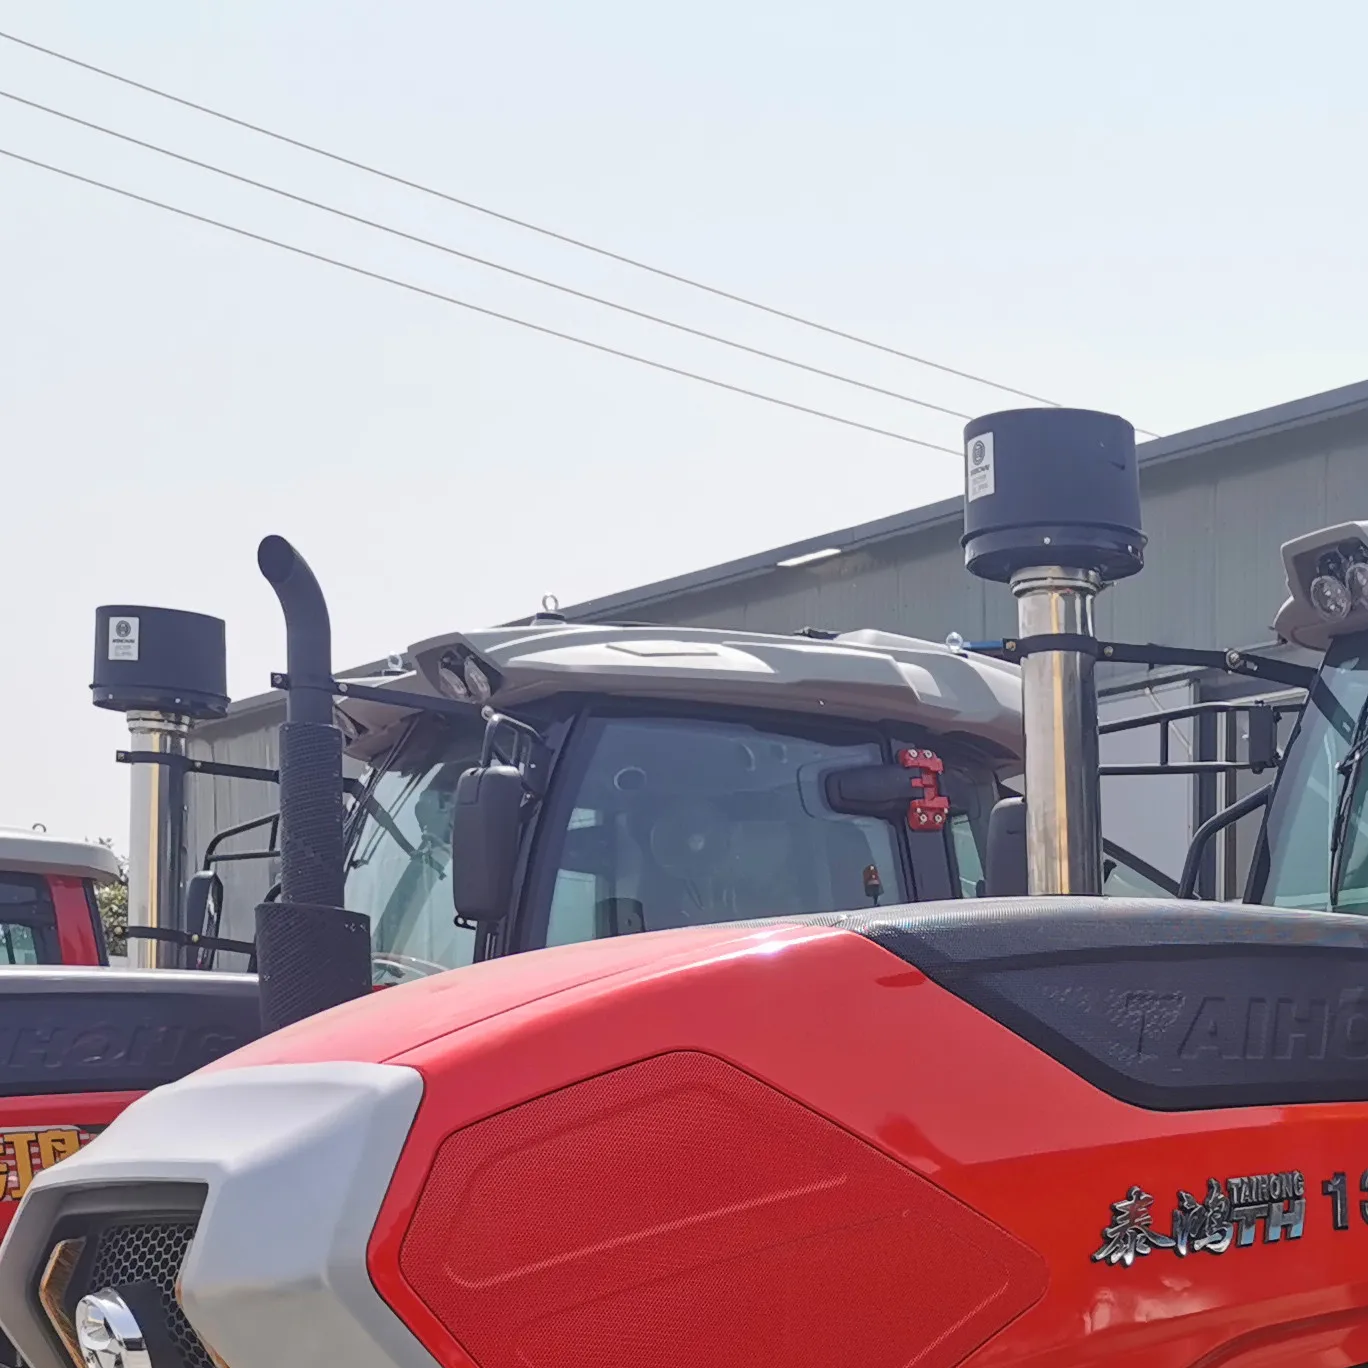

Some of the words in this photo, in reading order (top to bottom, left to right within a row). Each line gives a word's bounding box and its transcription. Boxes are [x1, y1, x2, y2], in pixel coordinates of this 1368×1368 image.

[1227, 1169, 1306, 1207] TAIHONG
[1089, 1177, 1232, 1268] 泰鸿
[1230, 1197, 1307, 1247] TH
